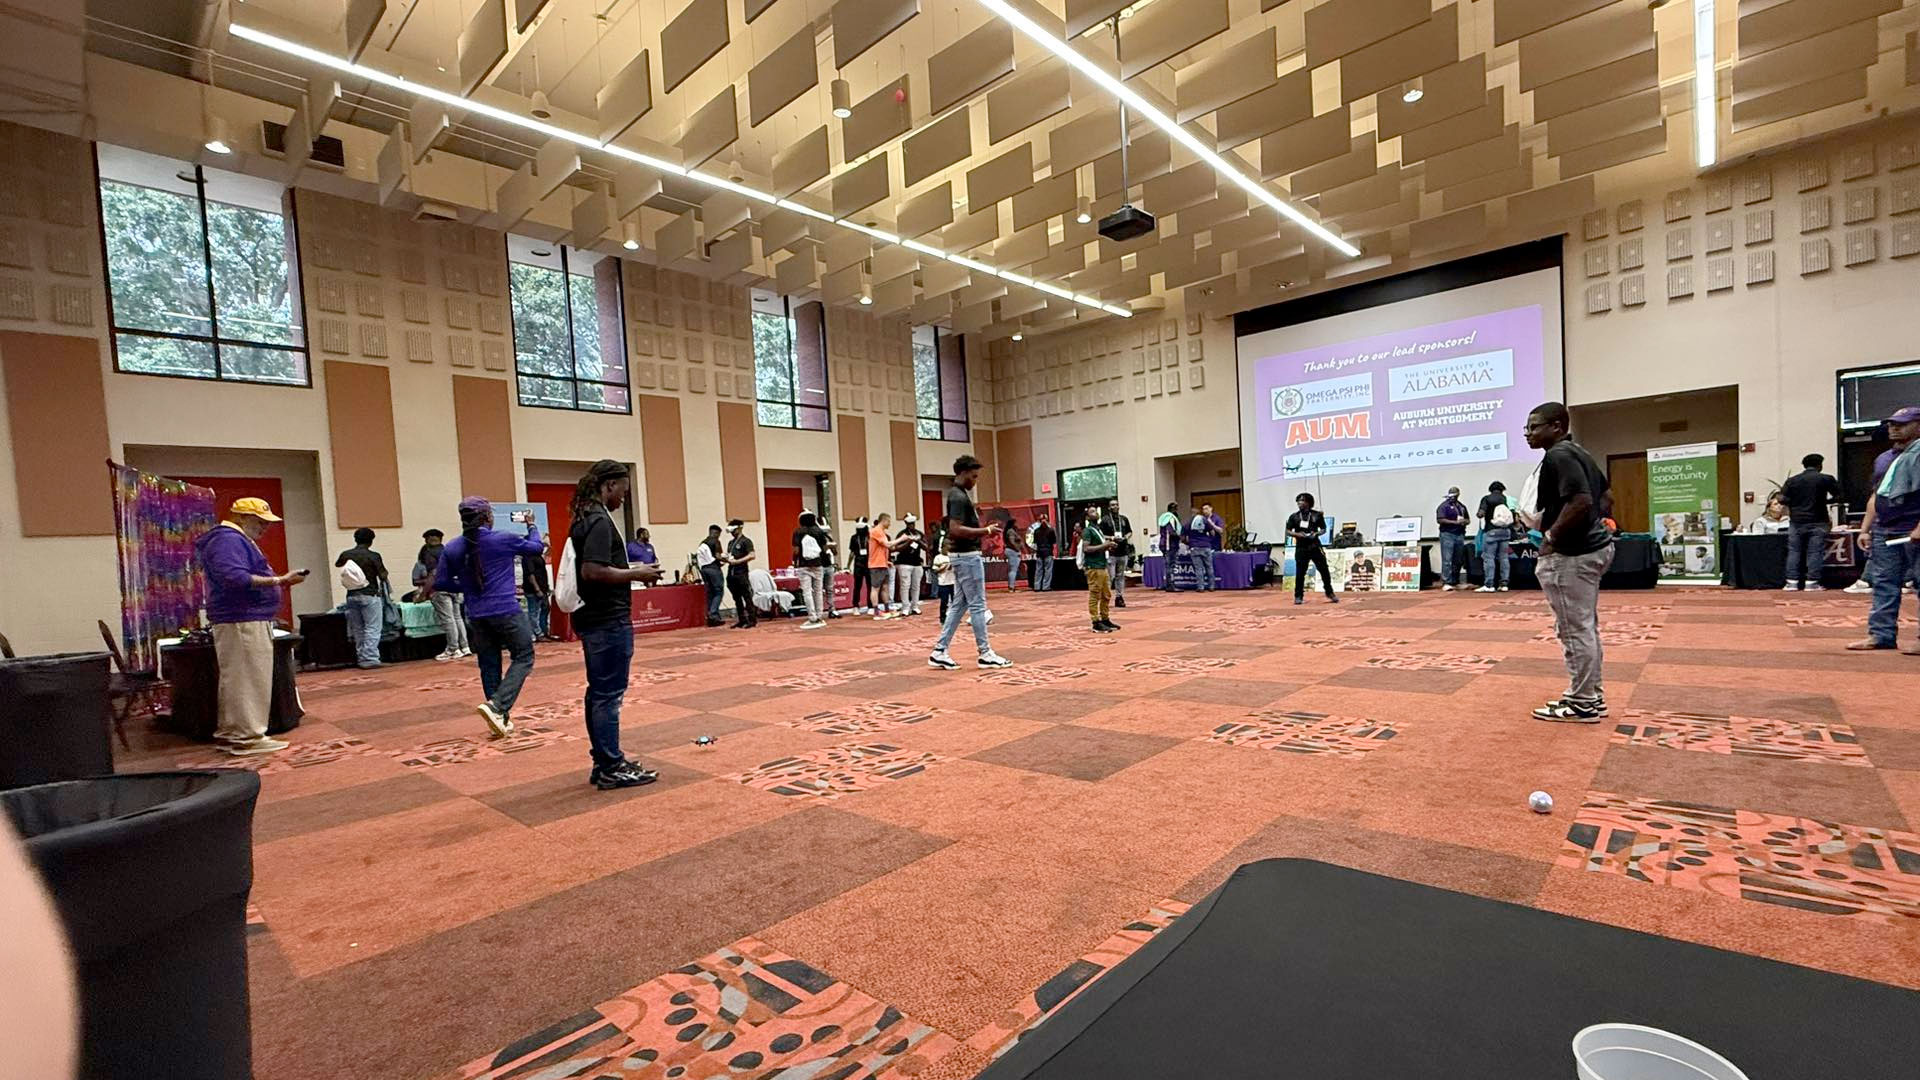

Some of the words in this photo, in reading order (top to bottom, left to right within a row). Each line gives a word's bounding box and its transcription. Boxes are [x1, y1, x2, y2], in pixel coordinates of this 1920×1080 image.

[1304, 360, 1336, 373] Thank
[1337, 356, 1355, 370] you
[1357, 353, 1369, 364] to
[1371, 351, 1390, 361] our
[1392, 342, 1417, 358] lead
[1418, 330, 1478, 354] sponsors!
[1423, 362, 1474, 376] UNIVERSITY
[1477, 360, 1489, 368] OF
[1402, 368, 1493, 394] ALABAMA
[1305, 389, 1337, 401] OMEGA
[1339, 385, 1353, 395] PSI
[1354, 383, 1370, 393] PHI
[1393, 407, 1435, 421] AUBURN
[1436, 399, 1504, 415] UNIVERSITY
[1285, 411, 1371, 449] AUM
[1401, 420, 1417, 430] AT
[1418, 411, 1494, 428] MONTGOMERY
[1311, 456, 1372, 466] MAXWELL
[1378, 452, 1401, 461] AIR
[1407, 447, 1453, 458] FORCE
[1461, 443, 1501, 453] BASE
[1652, 464, 1683, 474] Energy
[1685, 463, 1693, 471] is
[1652, 471, 1708, 483] opportunity
